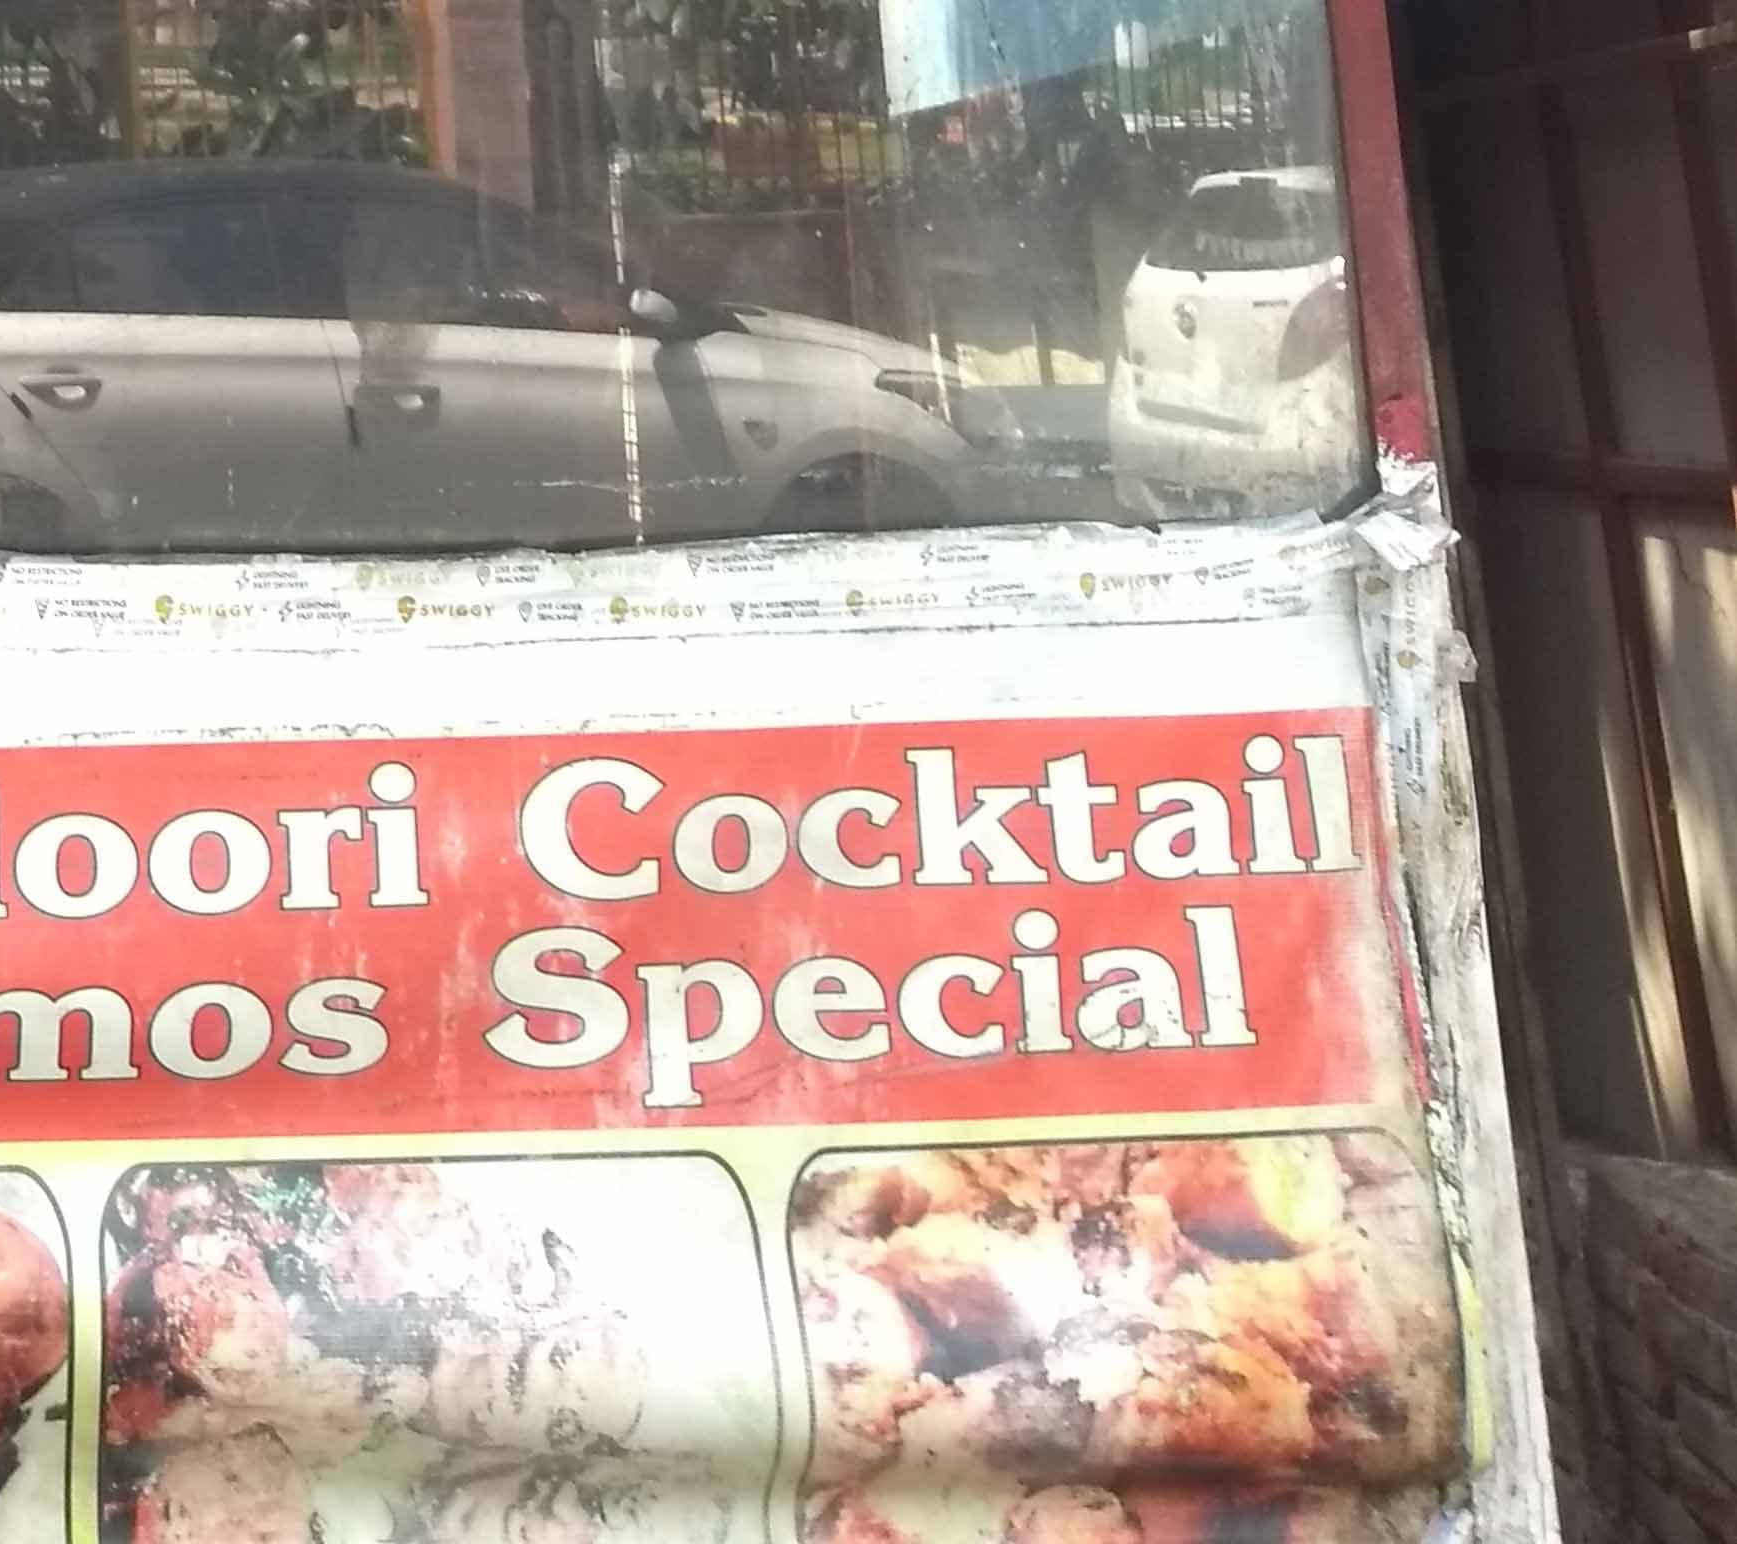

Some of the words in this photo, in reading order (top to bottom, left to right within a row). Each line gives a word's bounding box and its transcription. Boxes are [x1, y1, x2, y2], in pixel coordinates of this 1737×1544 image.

[178, 602, 254, 617] SWIGGY
[420, 602, 495, 618] SWIGGY
[630, 603, 706, 618] SWIGGY
[519, 734, 1365, 902] Cocktail
[483, 906, 1259, 1109] Special
